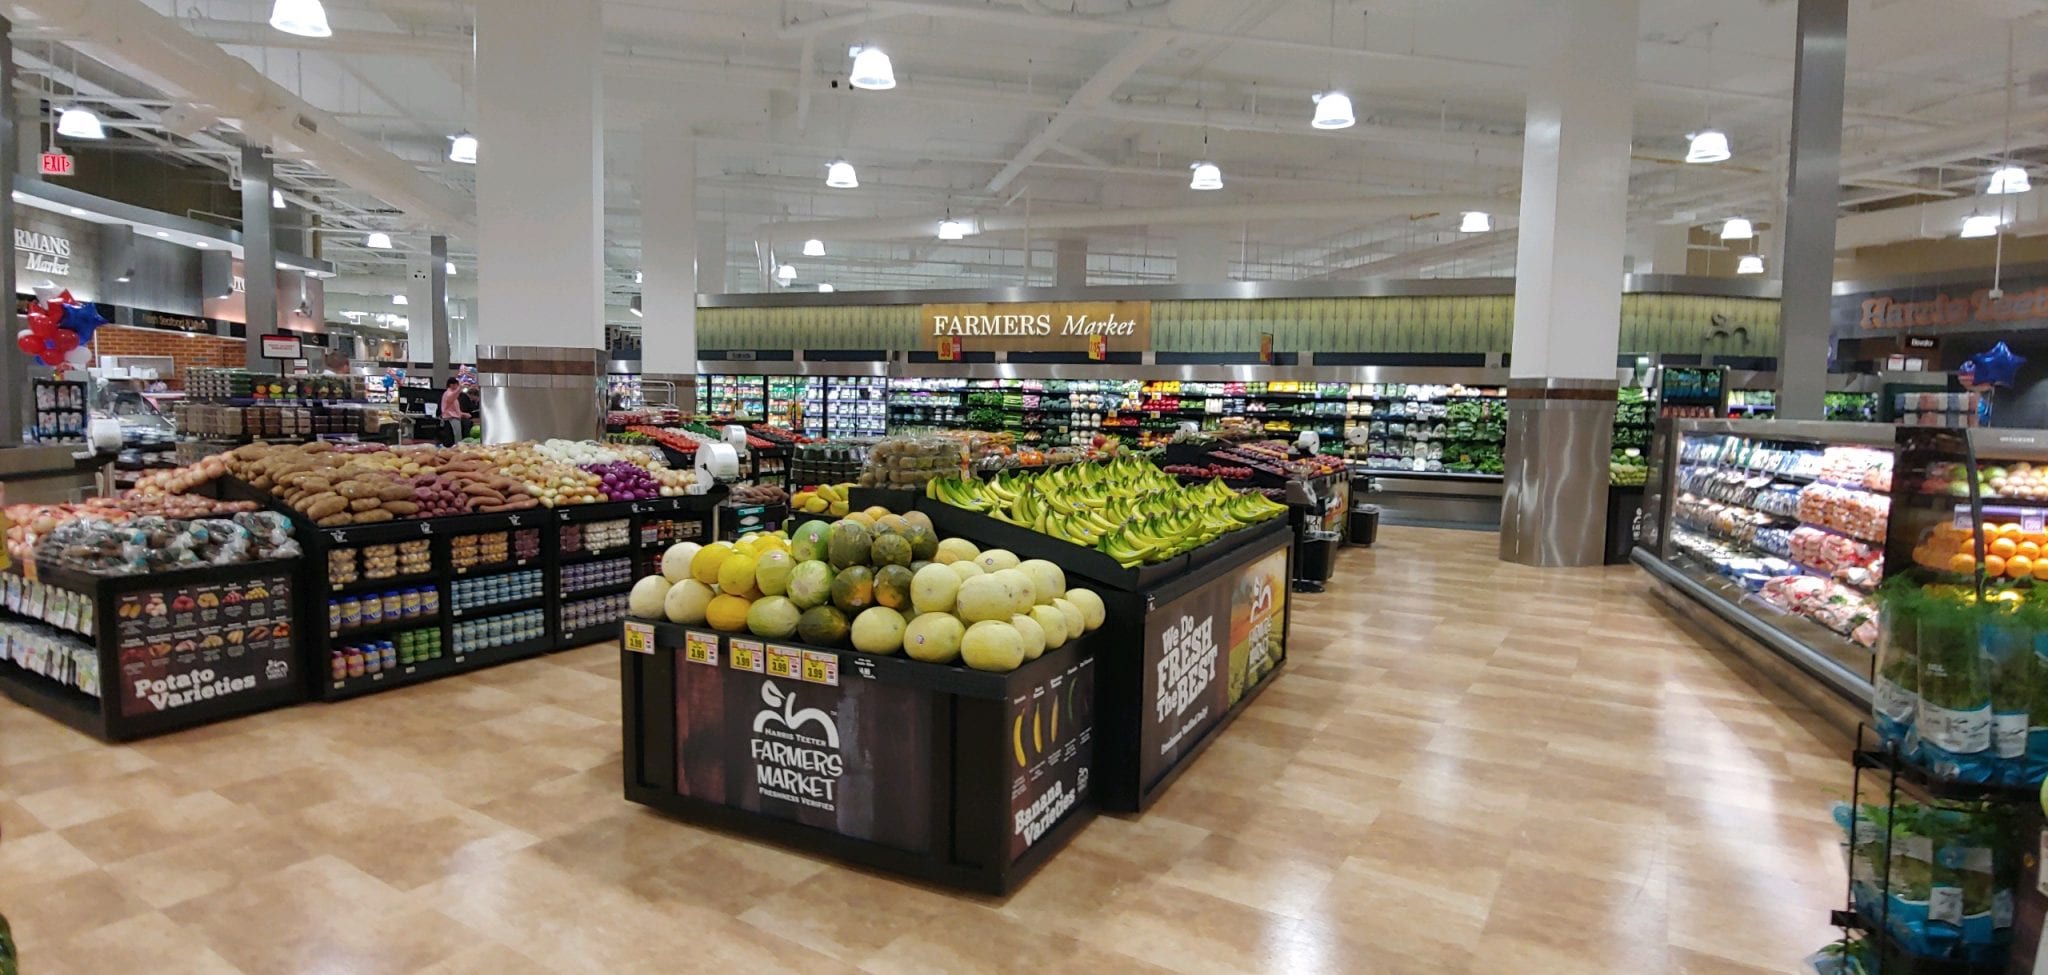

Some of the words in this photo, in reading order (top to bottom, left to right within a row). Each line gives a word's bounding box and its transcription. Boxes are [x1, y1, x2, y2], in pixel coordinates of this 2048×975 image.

[43, 155, 66, 172] EXIT
[25, 253, 70, 275] Market
[933, 314, 1051, 336] FARMERS
[1060, 313, 1136, 336] Market
[1162, 625, 1179, 654] We
[1180, 615, 1194, 640] Do
[1157, 615, 1213, 700] FRESH
[133, 668, 215, 698] Potato
[147, 674, 257, 711] Varieties
[1157, 690, 1178, 723] The
[1177, 644, 1218, 716] BEST
[751, 738, 843, 777] FARMERS
[795, 733, 827, 747] TEETER
[757, 764, 836, 801] MARKET
[1014, 780, 1063, 836] Banana
[1023, 788, 1076, 847] Varieties
